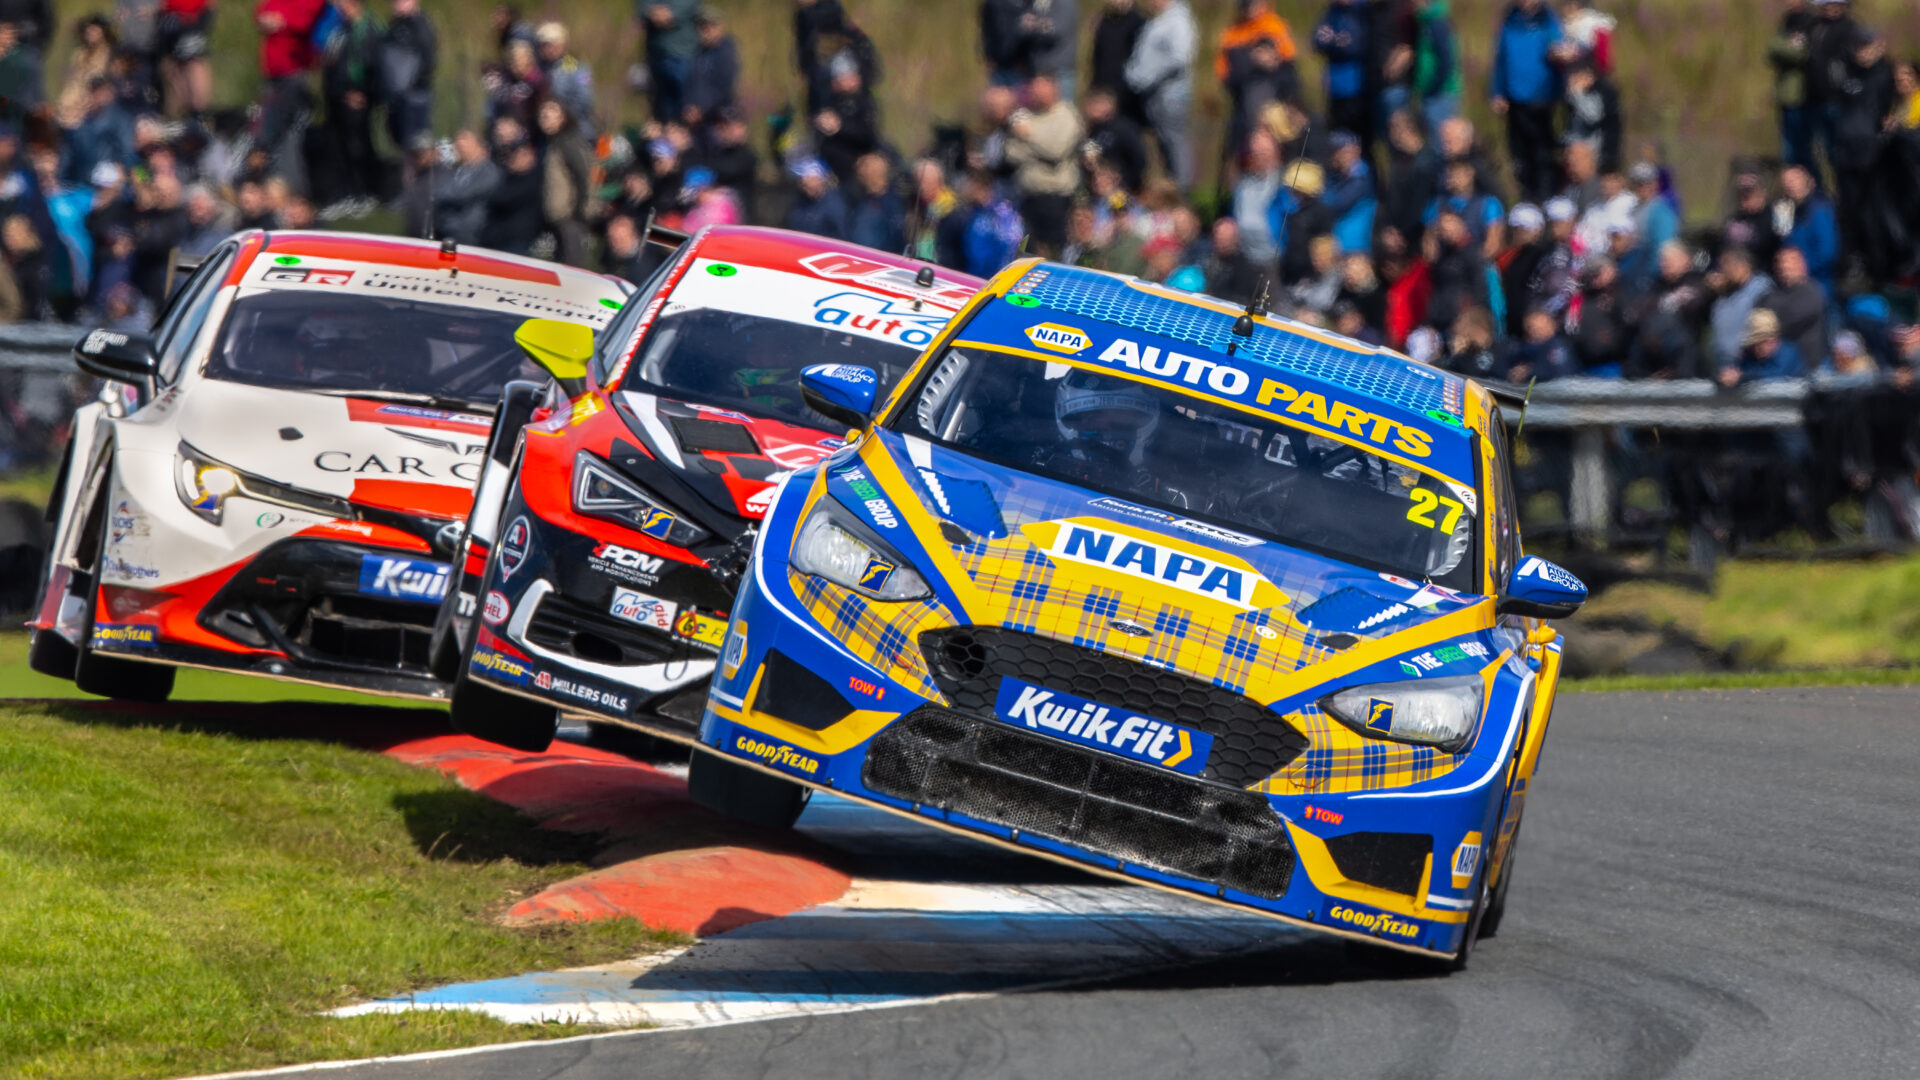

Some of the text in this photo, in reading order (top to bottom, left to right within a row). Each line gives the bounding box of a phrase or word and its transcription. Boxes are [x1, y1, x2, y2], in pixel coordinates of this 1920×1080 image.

[263, 268, 353, 286] GR
[363, 280, 475, 298] United
[814, 307, 933, 345] auto
[1035, 328, 1082, 348] NAPA
[1098, 338, 1250, 395] AUTO
[1256, 378, 1434, 458] PARTS
[314, 451, 436, 477] CAR
[864, 499, 898, 528] GROUP
[1406, 487, 1464, 536] 27
[600, 544, 664, 574] PCM
[1063, 527, 1243, 601] NAPA
[1549, 574, 1579, 591] GROUP
[613, 603, 648, 621] auto
[1411, 651, 1444, 671] THE
[552, 677, 628, 711] MILLERS OILS
[849, 676, 877, 696] TOW
[1315, 807, 1344, 825] TOW
[1329, 906, 1419, 937] GOODYEAR
